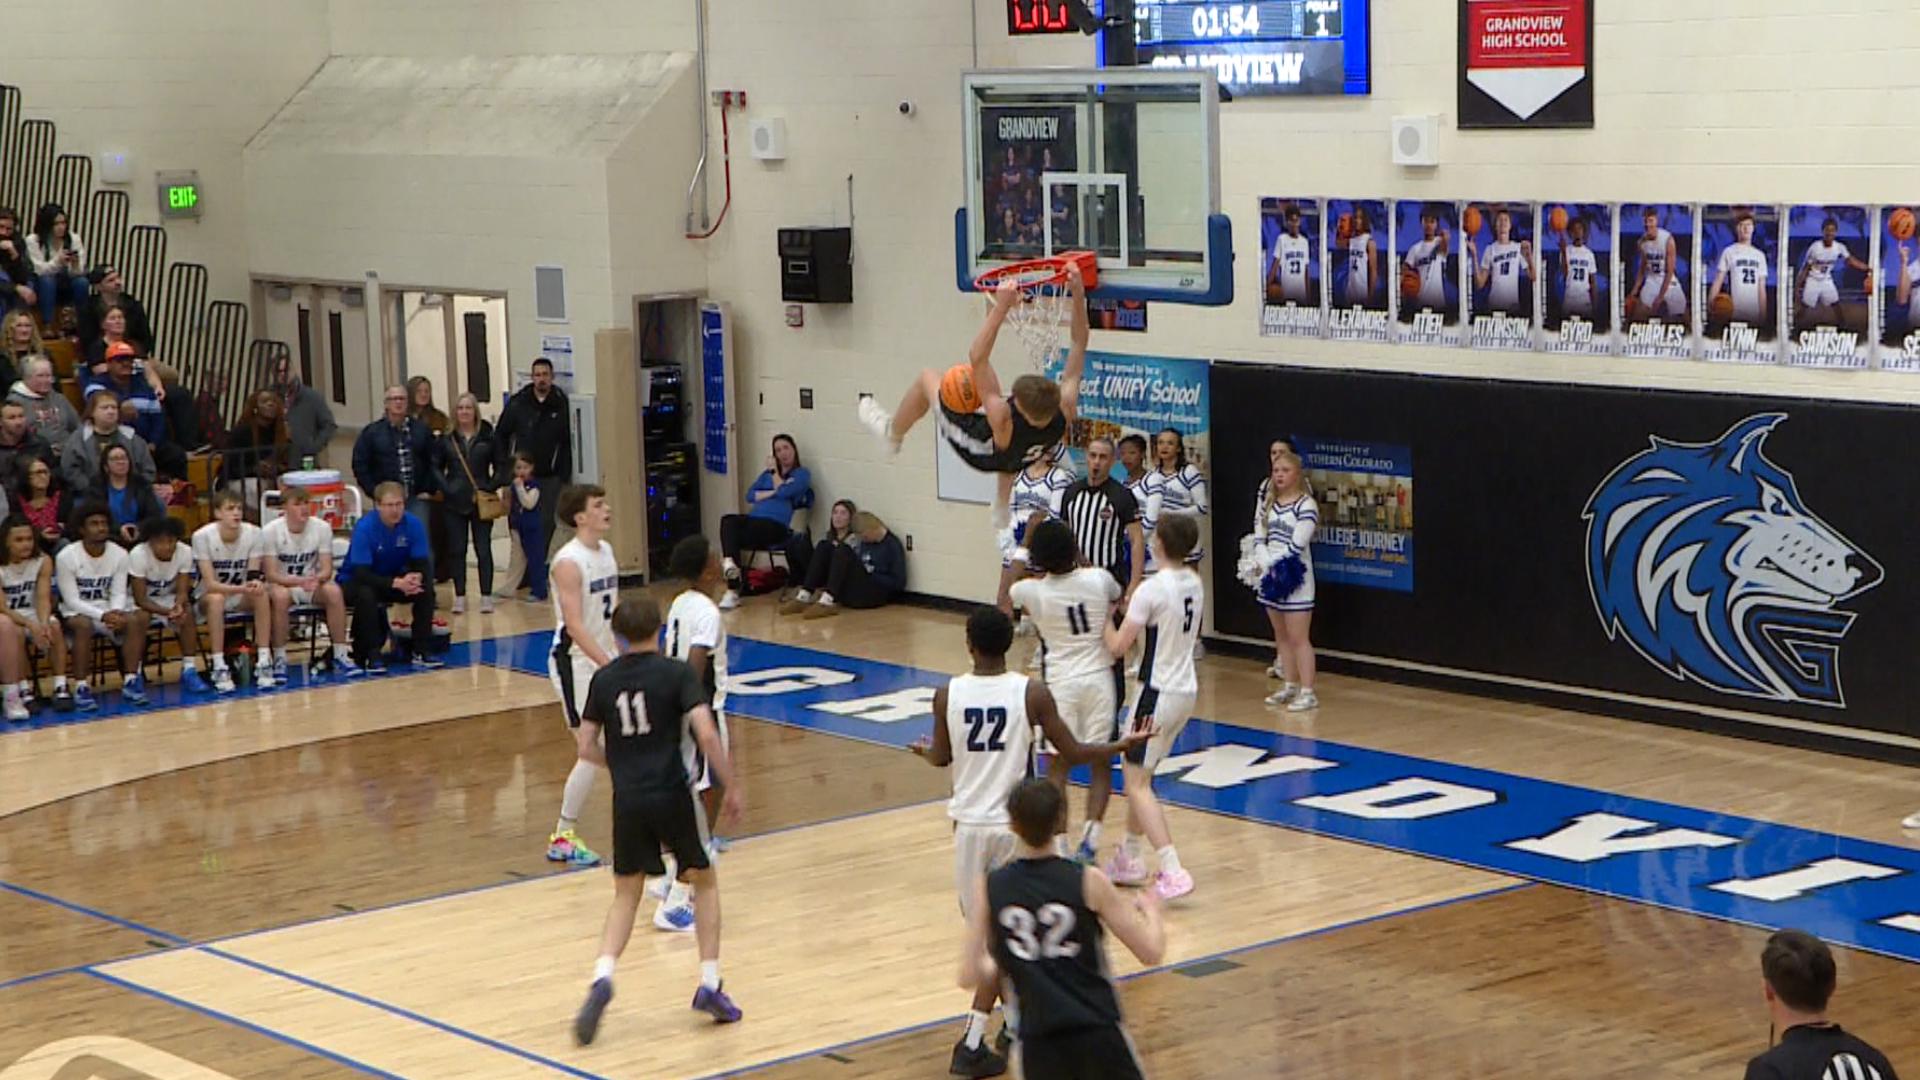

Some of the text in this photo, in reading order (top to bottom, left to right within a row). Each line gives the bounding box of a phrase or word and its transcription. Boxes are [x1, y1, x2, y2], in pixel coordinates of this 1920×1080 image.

[1192, 6, 1260, 36] 01:54
[1316, 14, 1329, 36] 1
[1486, 16, 1563, 32] GRANDVIEW
[1482, 33, 1567, 48] HIGH SCHOOL
[998, 117, 1059, 140] GRANDVIEW
[170, 186, 193, 208] EXIT
[1473, 316, 1529, 339] ATKINSON
[1560, 321, 1592, 342] BYRD
[1629, 323, 1684, 347] CHARLES
[1722, 327, 1758, 350] LYNN
[1799, 331, 1858, 356] SAMSON
[1103, 376, 1151, 400] UNIFY
[1151, 380, 1201, 406] School
[1358, 530, 1405, 552] JOURNEY
[1066, 602, 1090, 635] 11
[1183, 597, 1193, 633] 5
[615, 690, 651, 737] 11
[964, 707, 1007, 752] 22
[998, 903, 1082, 961] 32
